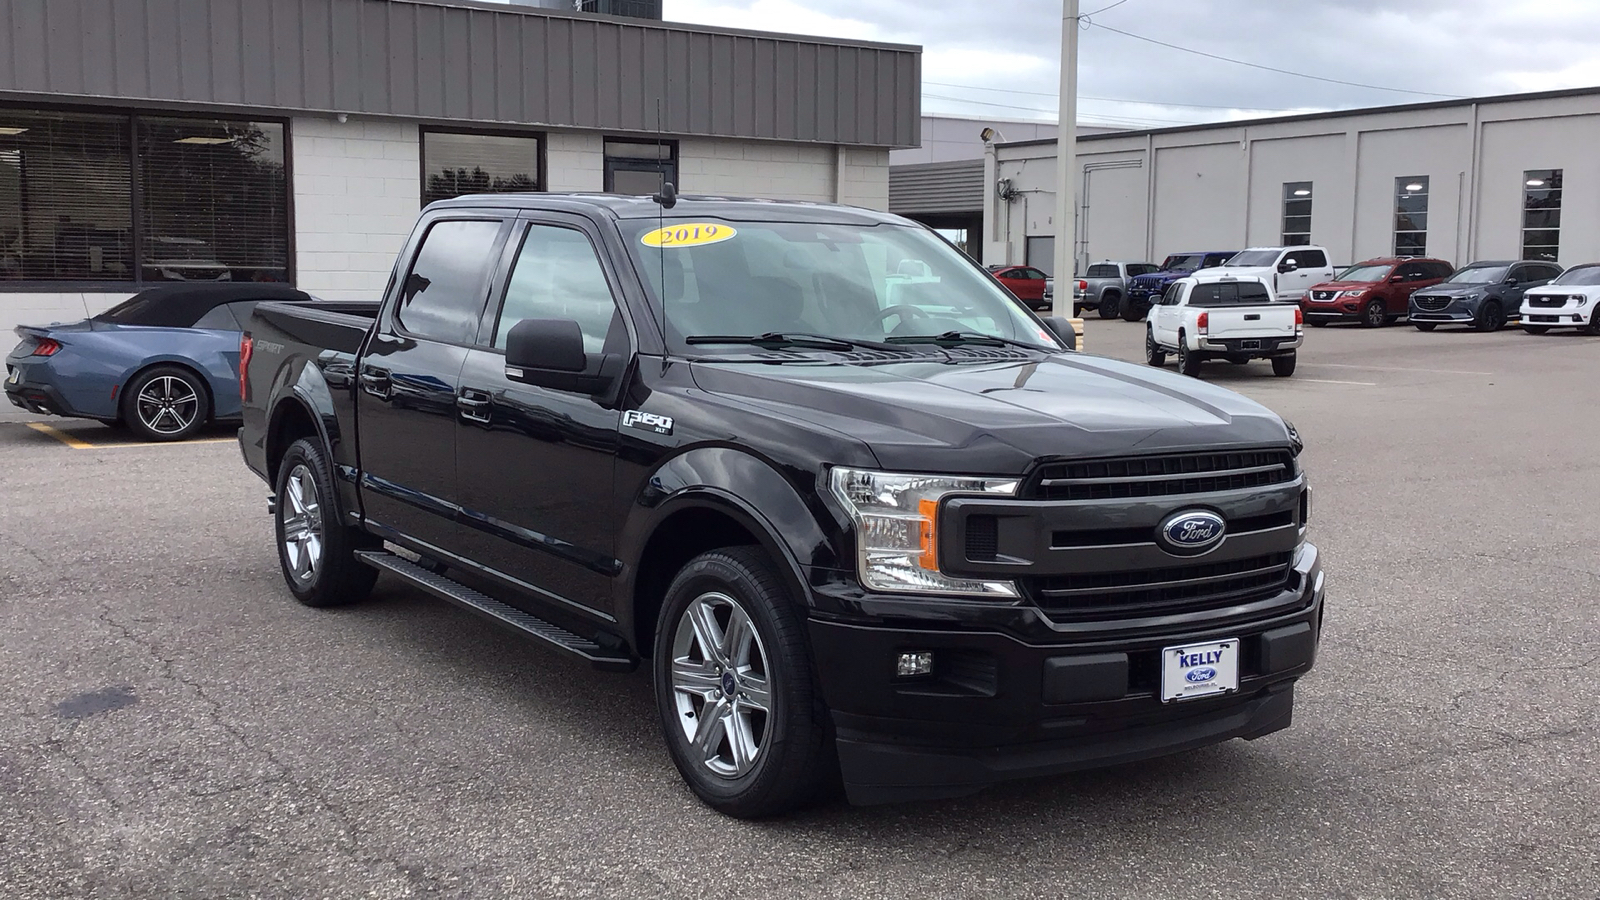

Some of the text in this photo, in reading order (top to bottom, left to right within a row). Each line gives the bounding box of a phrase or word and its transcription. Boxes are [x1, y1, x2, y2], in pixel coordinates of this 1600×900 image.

[660, 225, 718, 244] 2019
[255, 340, 285, 354] SPORT
[1180, 521, 1213, 541] Ford
[1180, 650, 1223, 668] KELLY
[1191, 668, 1212, 681] Ford
